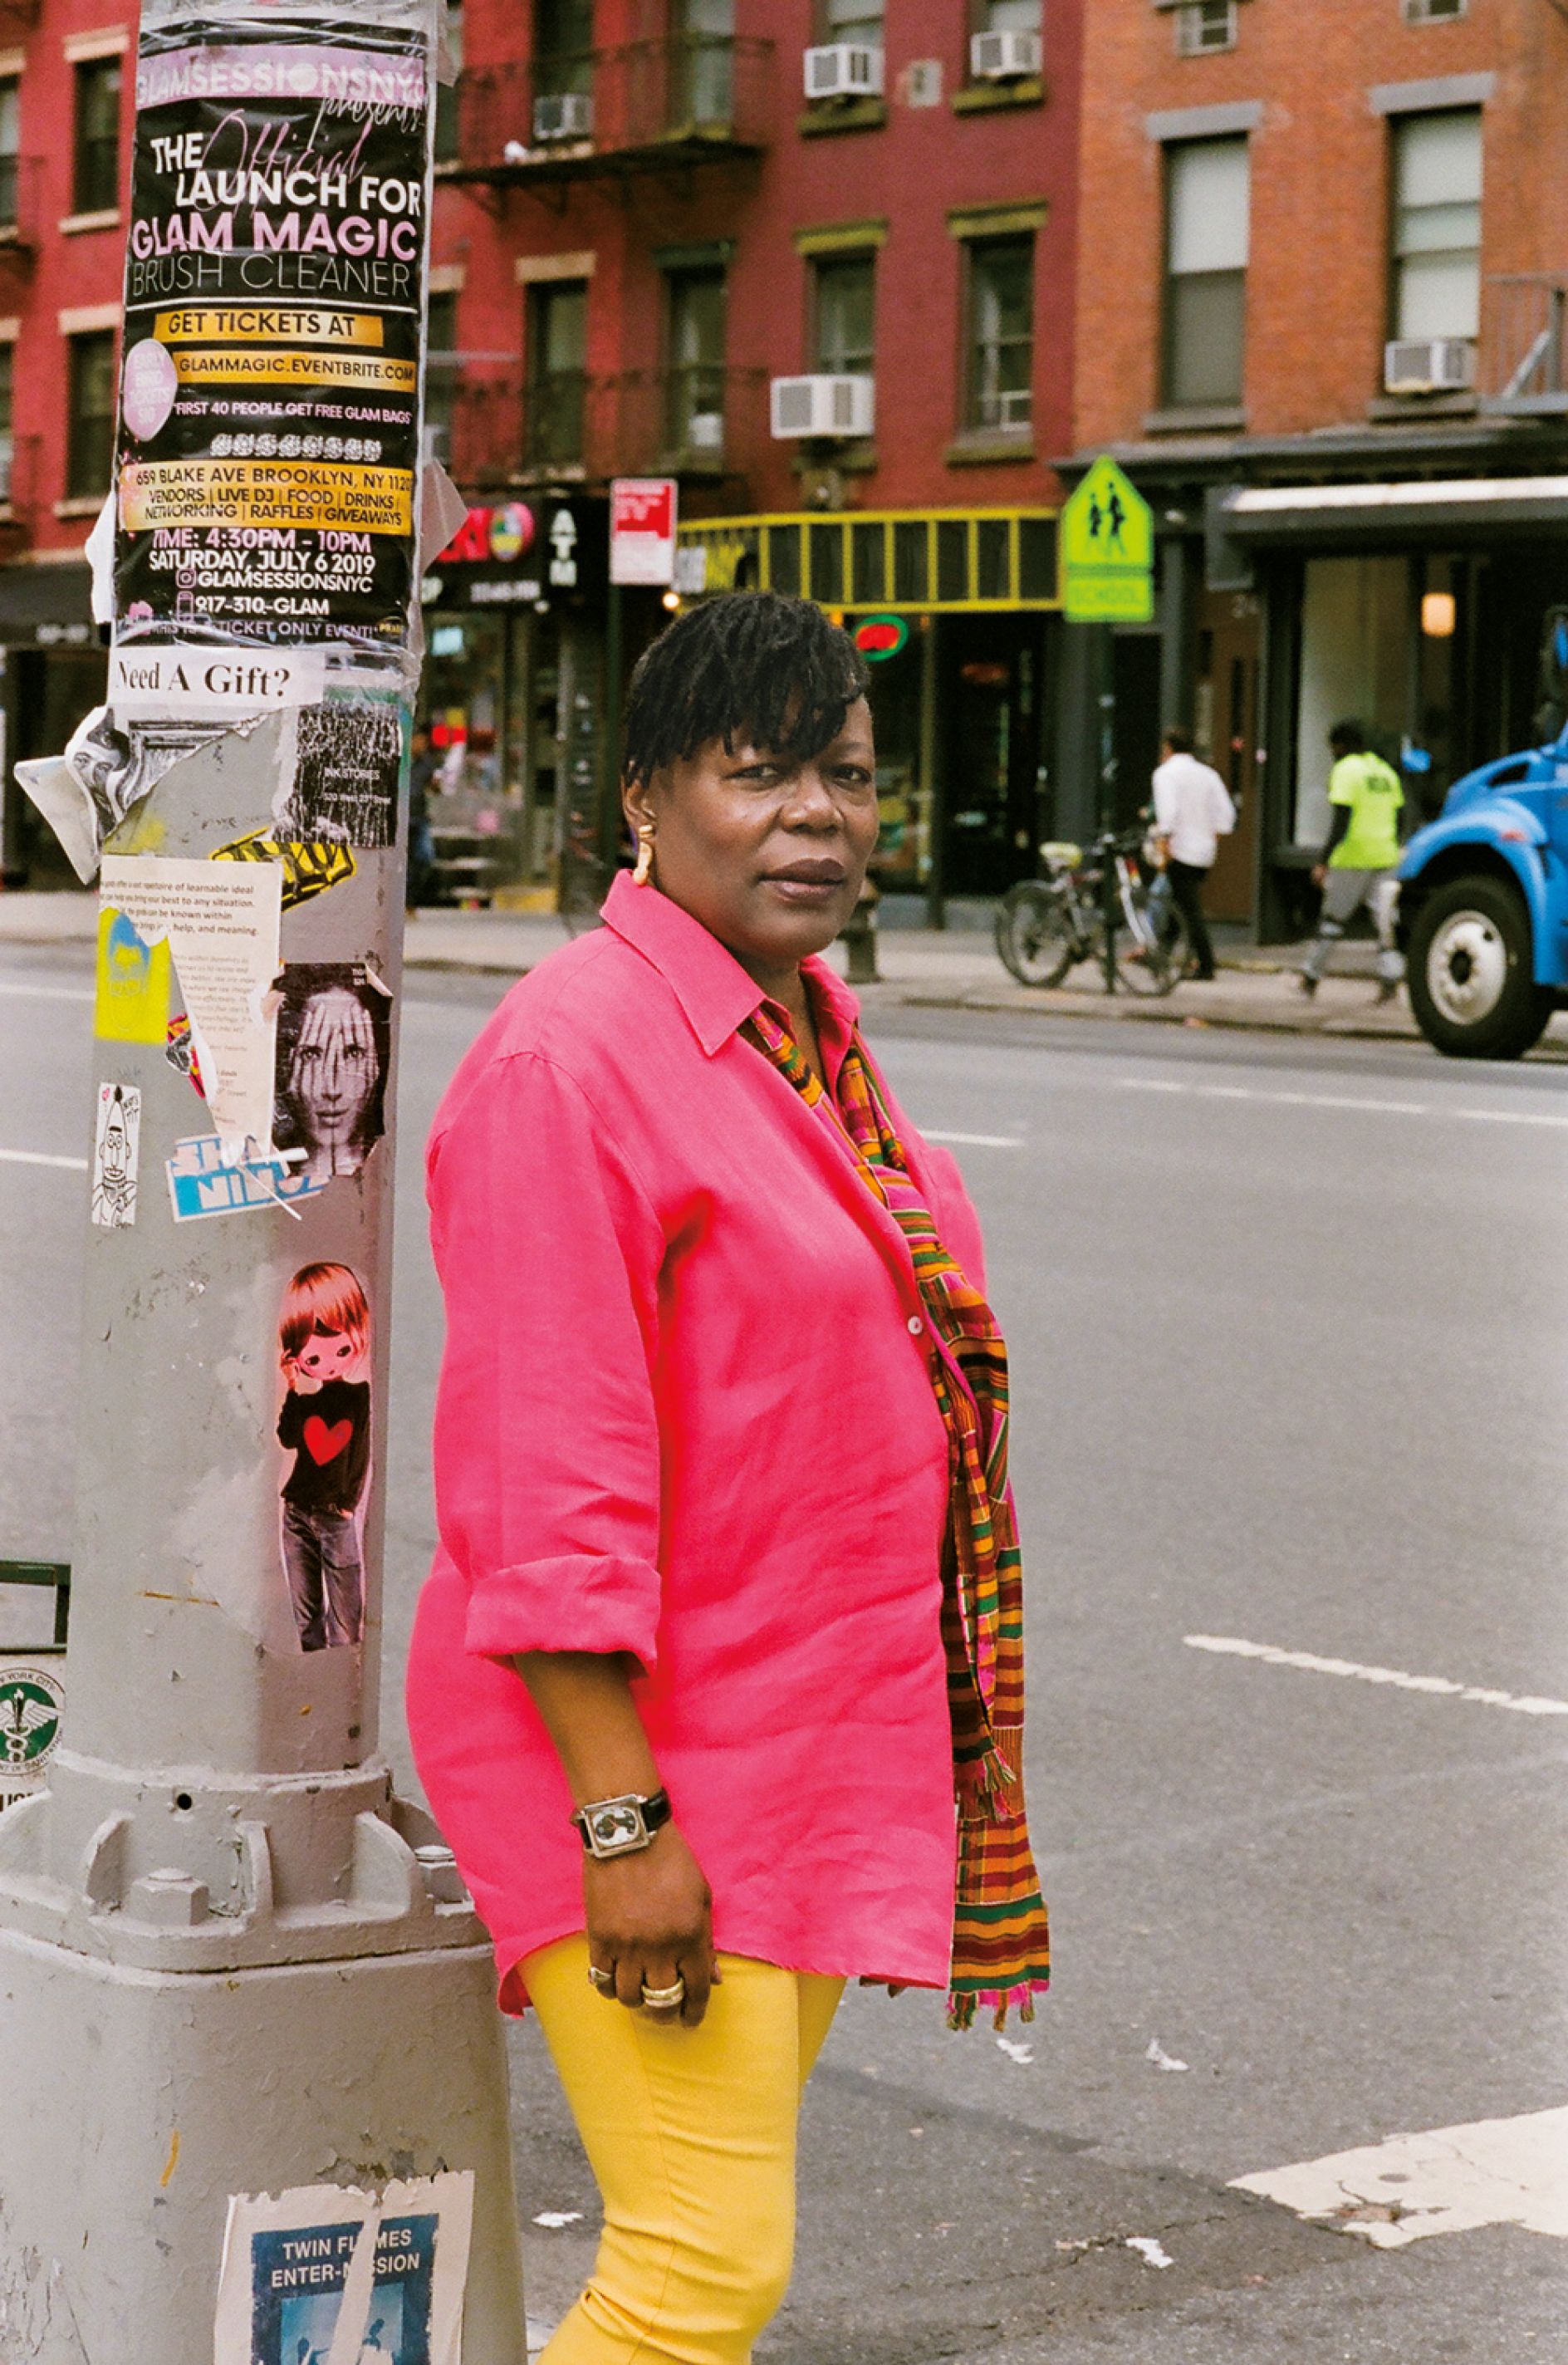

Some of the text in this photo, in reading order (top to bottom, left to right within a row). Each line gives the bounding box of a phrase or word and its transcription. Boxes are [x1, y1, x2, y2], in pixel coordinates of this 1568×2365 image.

[150, 133, 203, 174] THE
[176, 170, 421, 217] LAUNCH FOR
[132, 212, 417, 261] GLAM MAGIC
[133, 253, 410, 297] BRUSH CLEANER
[169, 312, 355, 336] GET TICKETS AT
[211, 401, 228, 415] 40
[233, 401, 282, 415] PEOPLE
[286, 402, 313, 415] GET
[316, 404, 343, 418] FREE
[345, 406, 380, 421] GLAM
[136, 469, 155, 485] 659
[159, 467, 205, 483] BLAKE
[210, 467, 245, 482] AVE
[252, 468, 358, 488] BROOKLYN,
[364, 472, 385, 488] NY
[149, 488, 394, 509] VENDORS LIVE DJ FOOD DRINKS
[145, 504, 402, 527] NETWORKING RAFFLES GIVEAWAYS
[153, 528, 200, 549] TIME:
[205, 528, 295, 549] 4:30PM
[317, 531, 371, 553] 10PM
[149, 550, 375, 574] SATURDAY, JULY 6 2019
[279, 622, 324, 636] ONLY
[115, 660, 291, 697] Need A Gift?
[174, 883, 185, 891] of
[187, 883, 229, 893] learnable
[232, 884, 254, 894] ideal
[282, 2228, 412, 2261] TWIN FLMES
